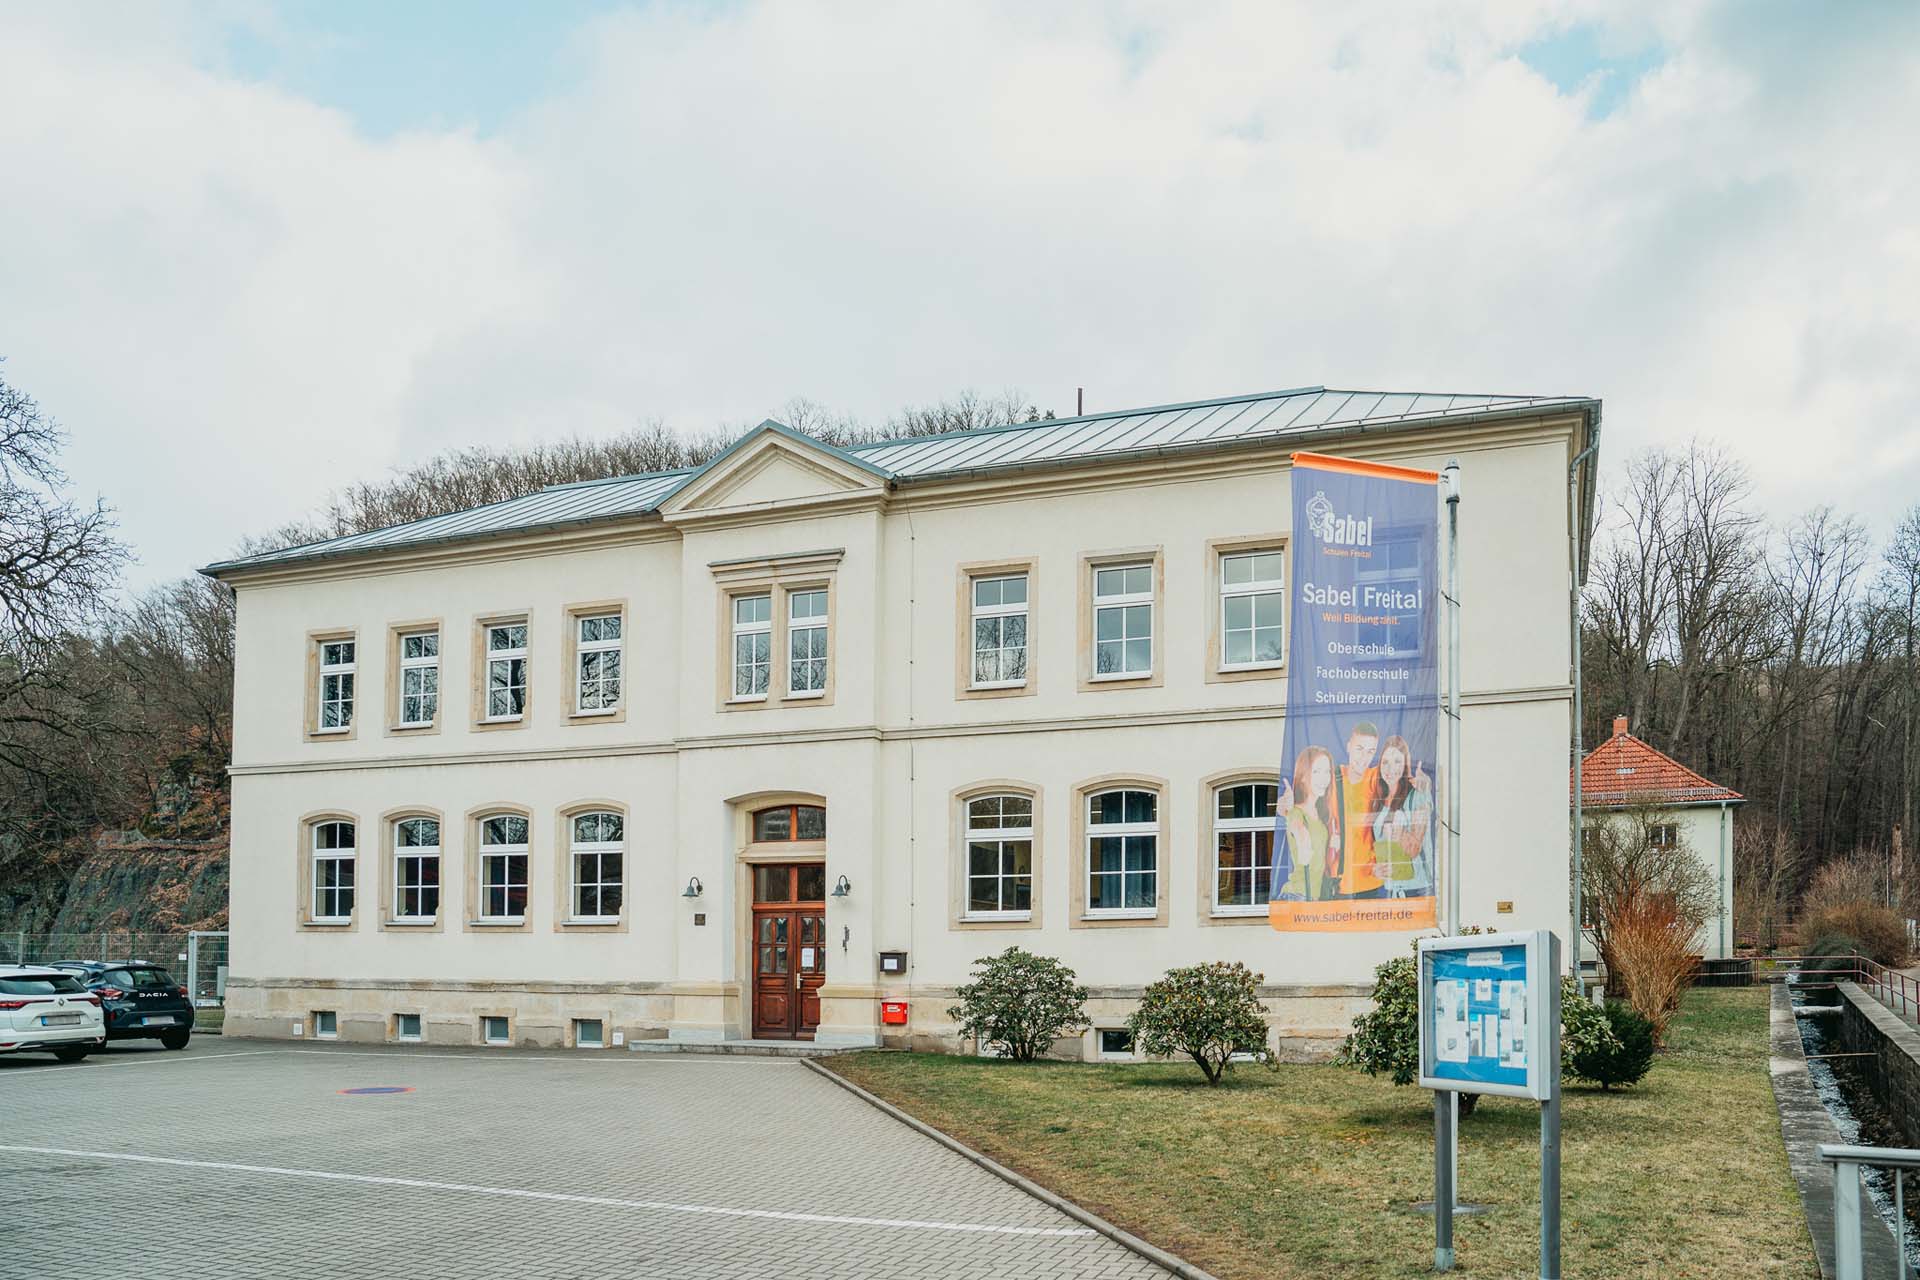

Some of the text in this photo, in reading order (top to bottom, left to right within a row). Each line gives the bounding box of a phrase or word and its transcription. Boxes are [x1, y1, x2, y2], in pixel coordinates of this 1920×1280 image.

[1323, 511, 1373, 546] Sabel
[1303, 582, 1422, 609] Sabel Freital
[1322, 611, 1342, 623] Weil
[1344, 612, 1379, 625] Bildung
[1327, 641, 1395, 656] Oberschule
[1316, 666, 1409, 680] Fachoberschule
[1315, 691, 1407, 704] Schülerzentrum
[1294, 908, 1413, 923] www.sabel-freital.de
